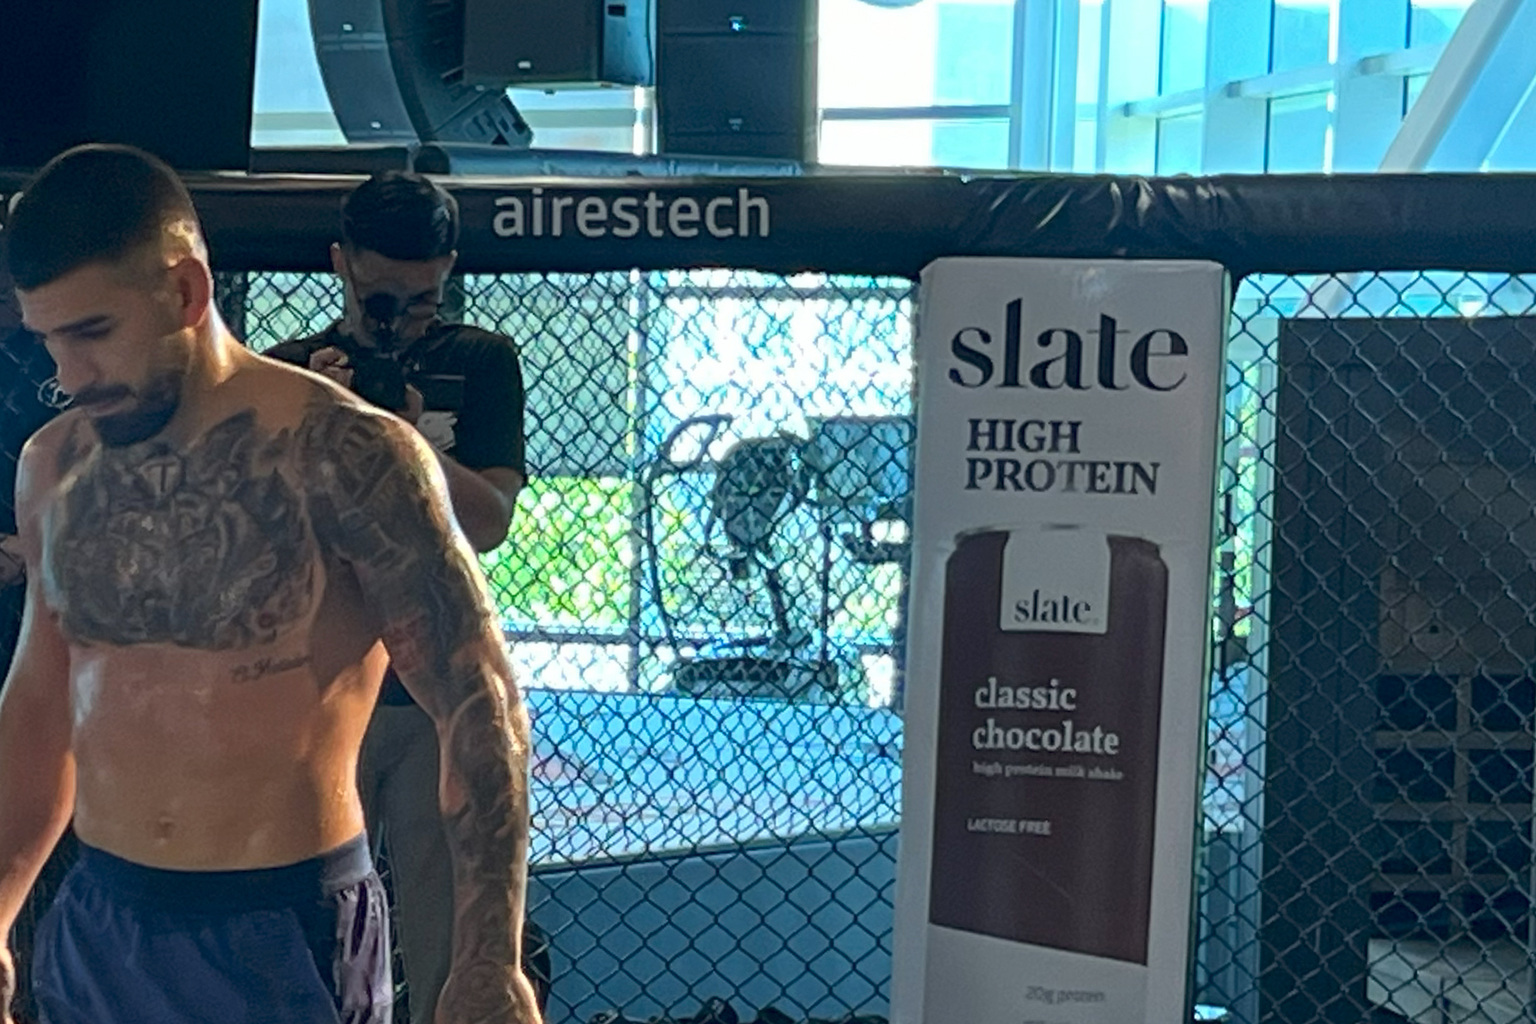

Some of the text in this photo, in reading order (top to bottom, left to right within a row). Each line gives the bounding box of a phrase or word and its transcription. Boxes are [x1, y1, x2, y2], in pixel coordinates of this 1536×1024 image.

[493, 187, 770, 238] airestech
[947, 297, 1189, 392] slate
[966, 418, 1083, 454] HIGH
[964, 457, 1161, 495] PROTEIN
[1013, 589, 1092, 625] slate
[974, 676, 1077, 711] classic
[972, 717, 1120, 755] chocolate
[966, 817, 1052, 836] LACTOSE FREE
